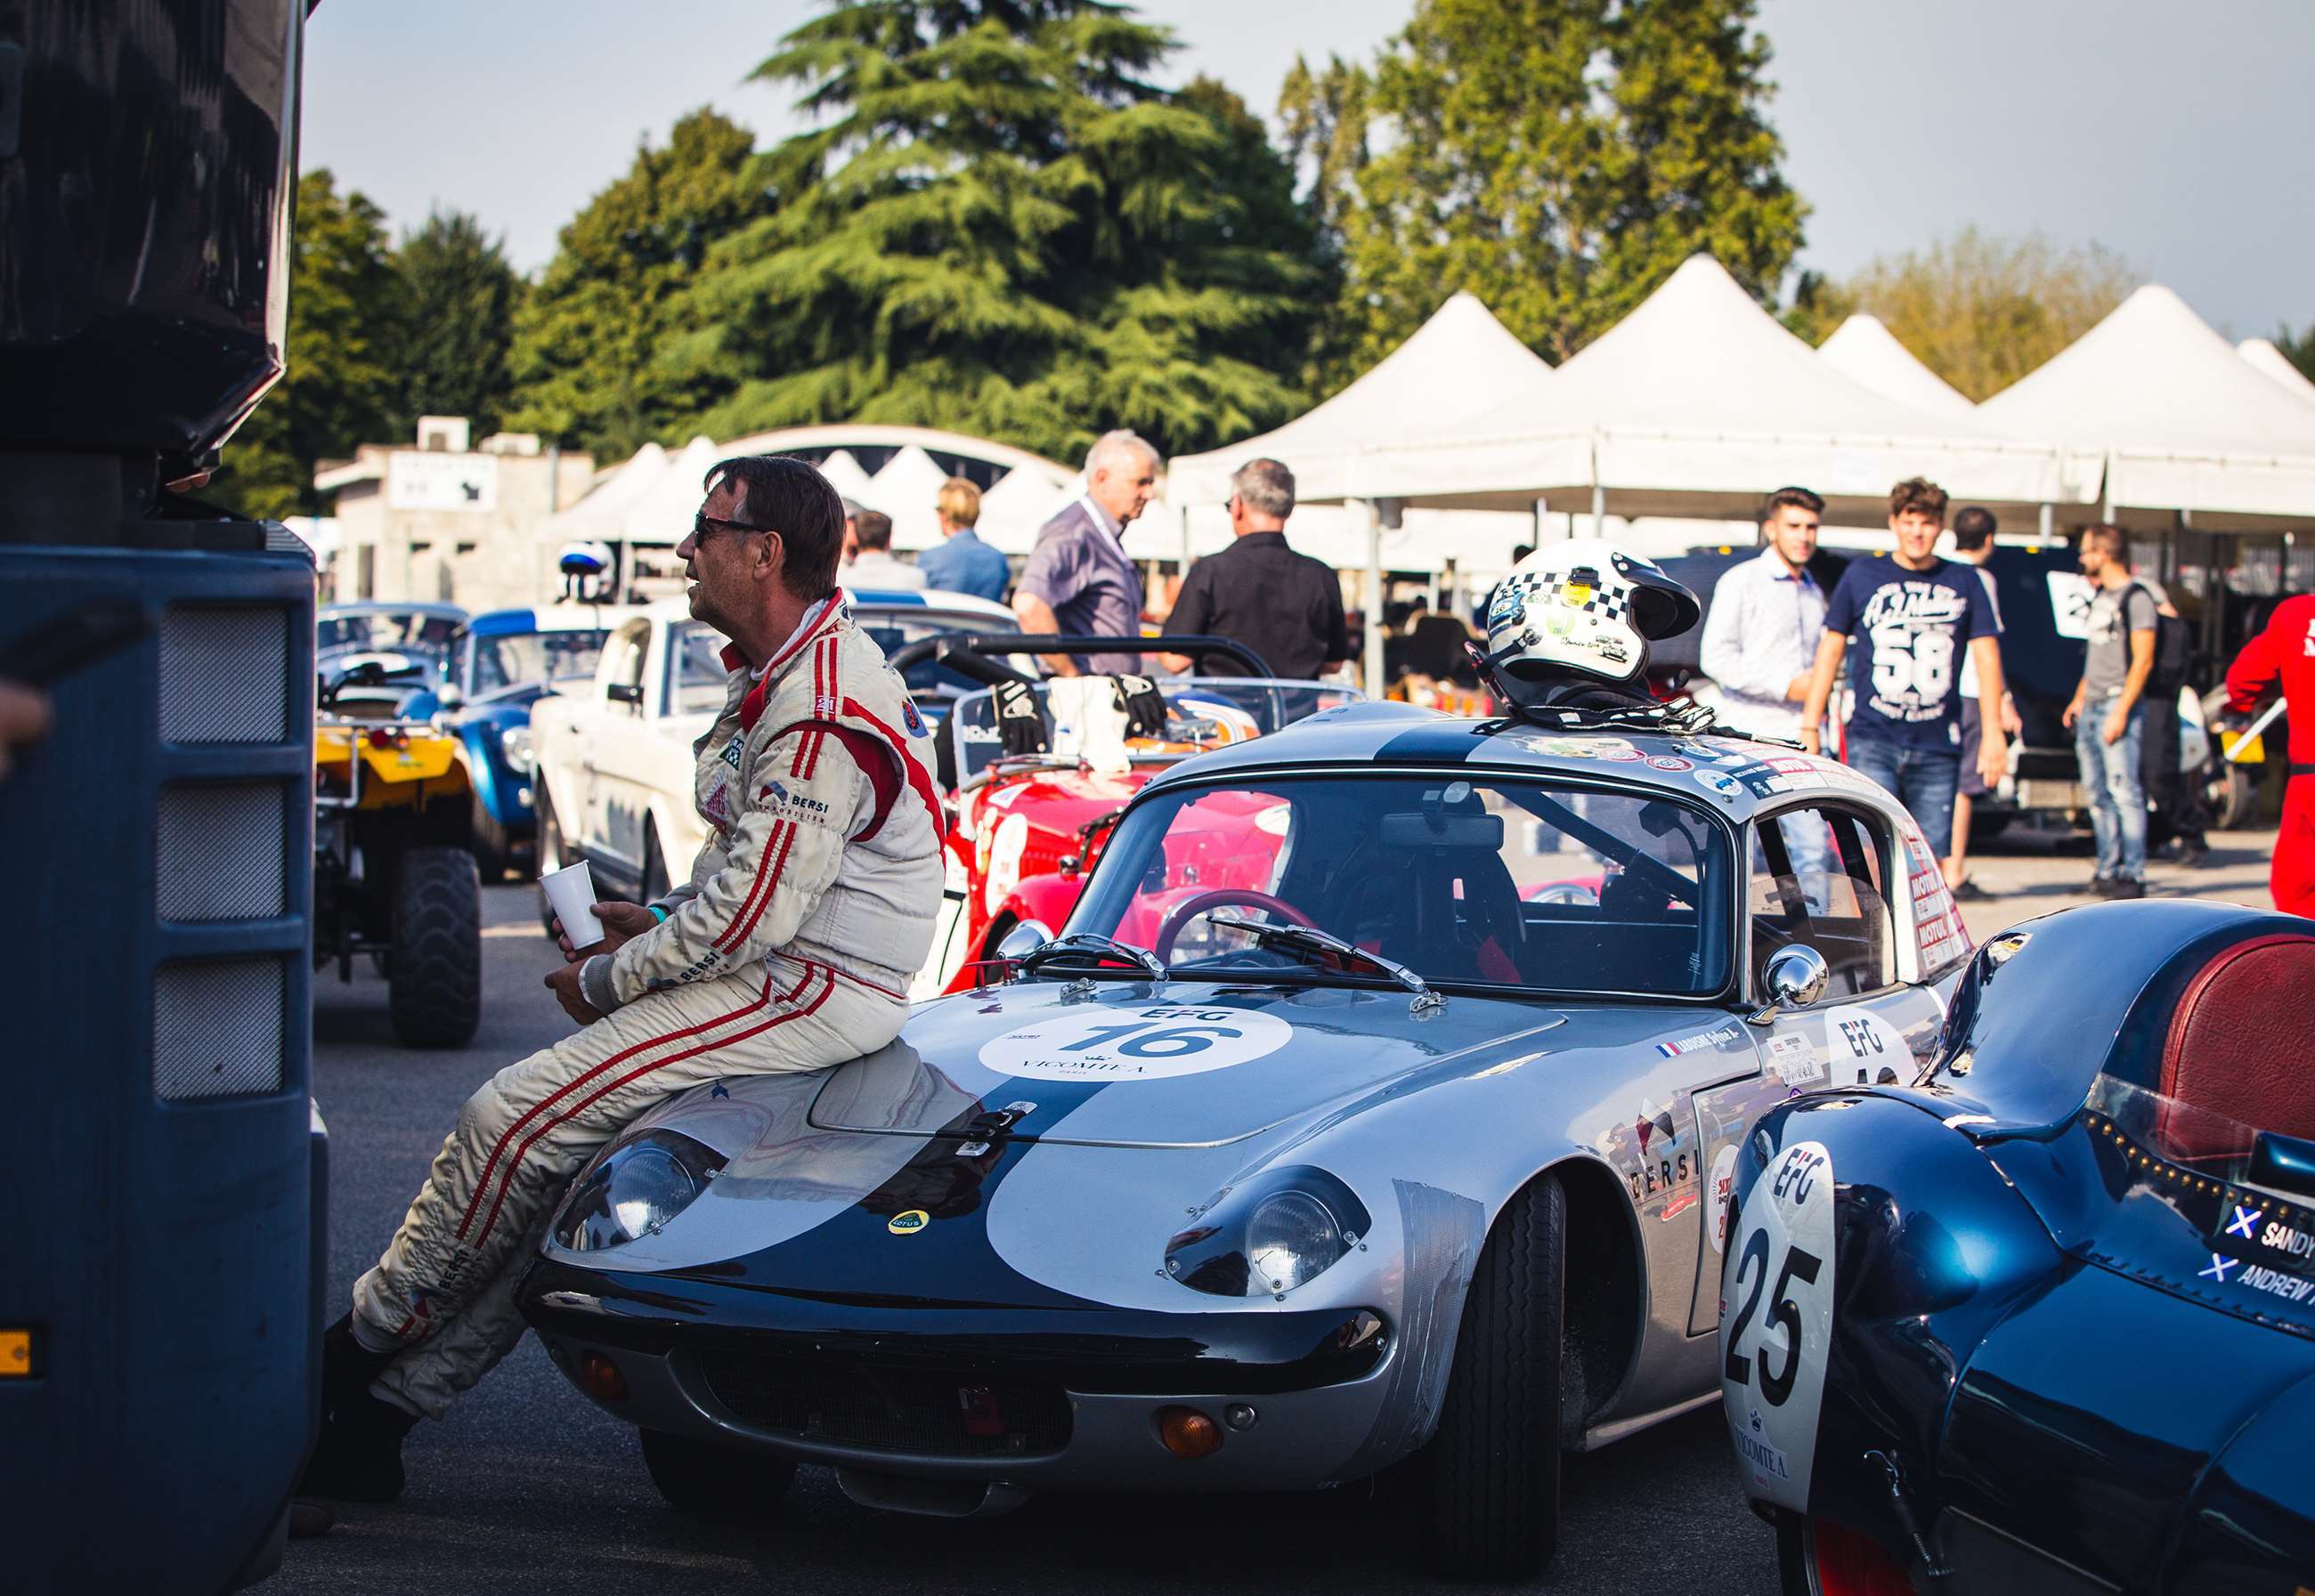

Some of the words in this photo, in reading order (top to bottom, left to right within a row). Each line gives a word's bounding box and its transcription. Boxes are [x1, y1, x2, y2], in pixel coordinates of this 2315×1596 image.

[1870, 624, 1954, 701] 58
[792, 795, 829, 814] BERSI
[1911, 872, 1938, 899] MOTUL
[1918, 917, 1948, 947] MOTUL
[680, 951, 719, 981] BERSI
[1140, 1009, 1235, 1021] EFG
[1057, 1022, 1243, 1058] 16
[1839, 1019, 1883, 1057] EFG
[1020, 1060, 1126, 1071] VICOMTE
[1630, 1149, 1699, 1199] BERSI
[1774, 1148, 1824, 1204] EFG
[2262, 1221, 2315, 1259] SANDY
[2237, 1264, 2314, 1300] ANDREW
[1726, 1228, 1823, 1406] 25
[1735, 1427, 1775, 1472] VICOMTE
